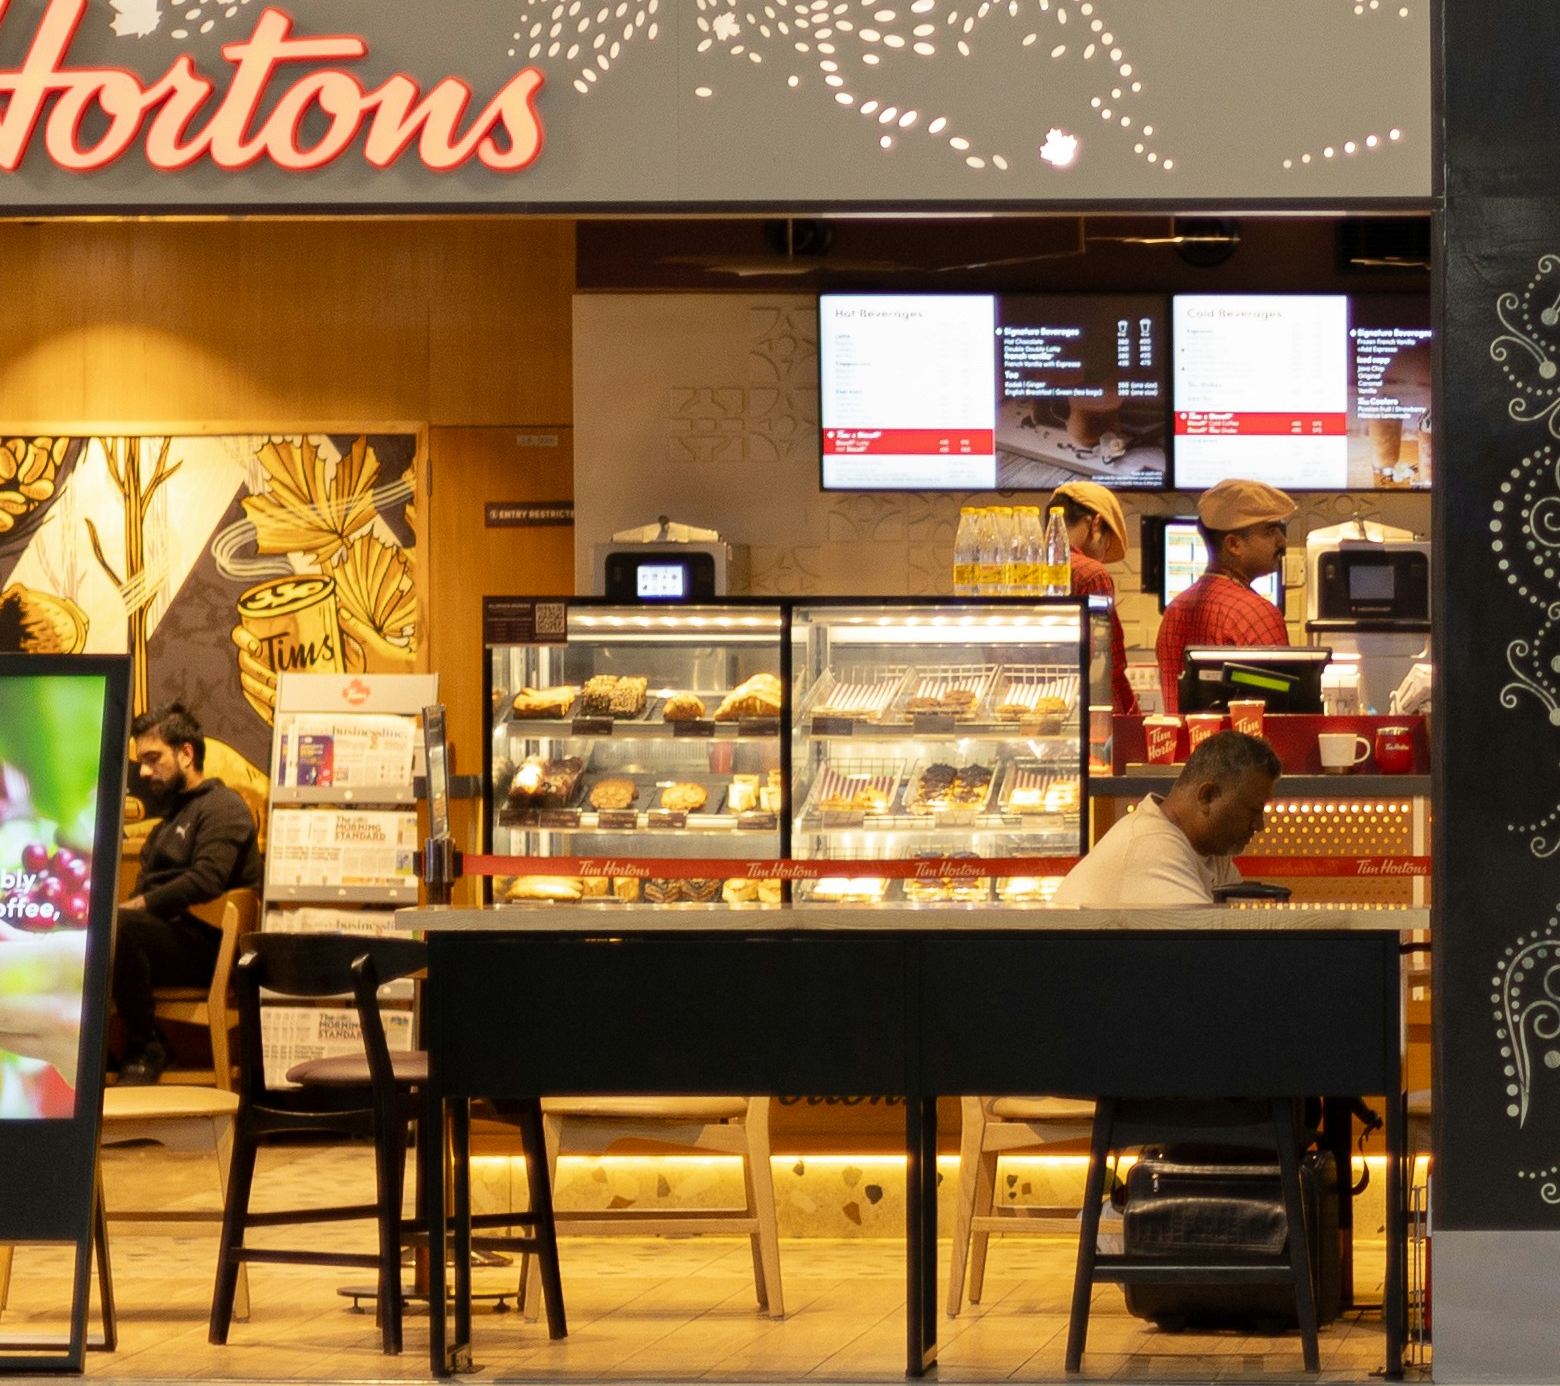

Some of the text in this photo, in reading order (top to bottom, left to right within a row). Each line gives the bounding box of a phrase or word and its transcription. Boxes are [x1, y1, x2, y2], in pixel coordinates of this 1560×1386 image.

[835, 308, 923, 320] Hot Beverages
[1219, 309, 1283, 321] Beverages
[259, 631, 335, 673] Tims
[1150, 727, 1172, 744] Tim
[335, 832, 386, 841] STANDARD
[579, 860, 650, 878] Tim Hortons
[747, 861, 819, 878] Tim Hortons
[914, 861, 987, 877] Tim Hortons
[1356, 859, 1427, 875] Tim Hortons
[319, 1021, 360, 1029] MORNIN
